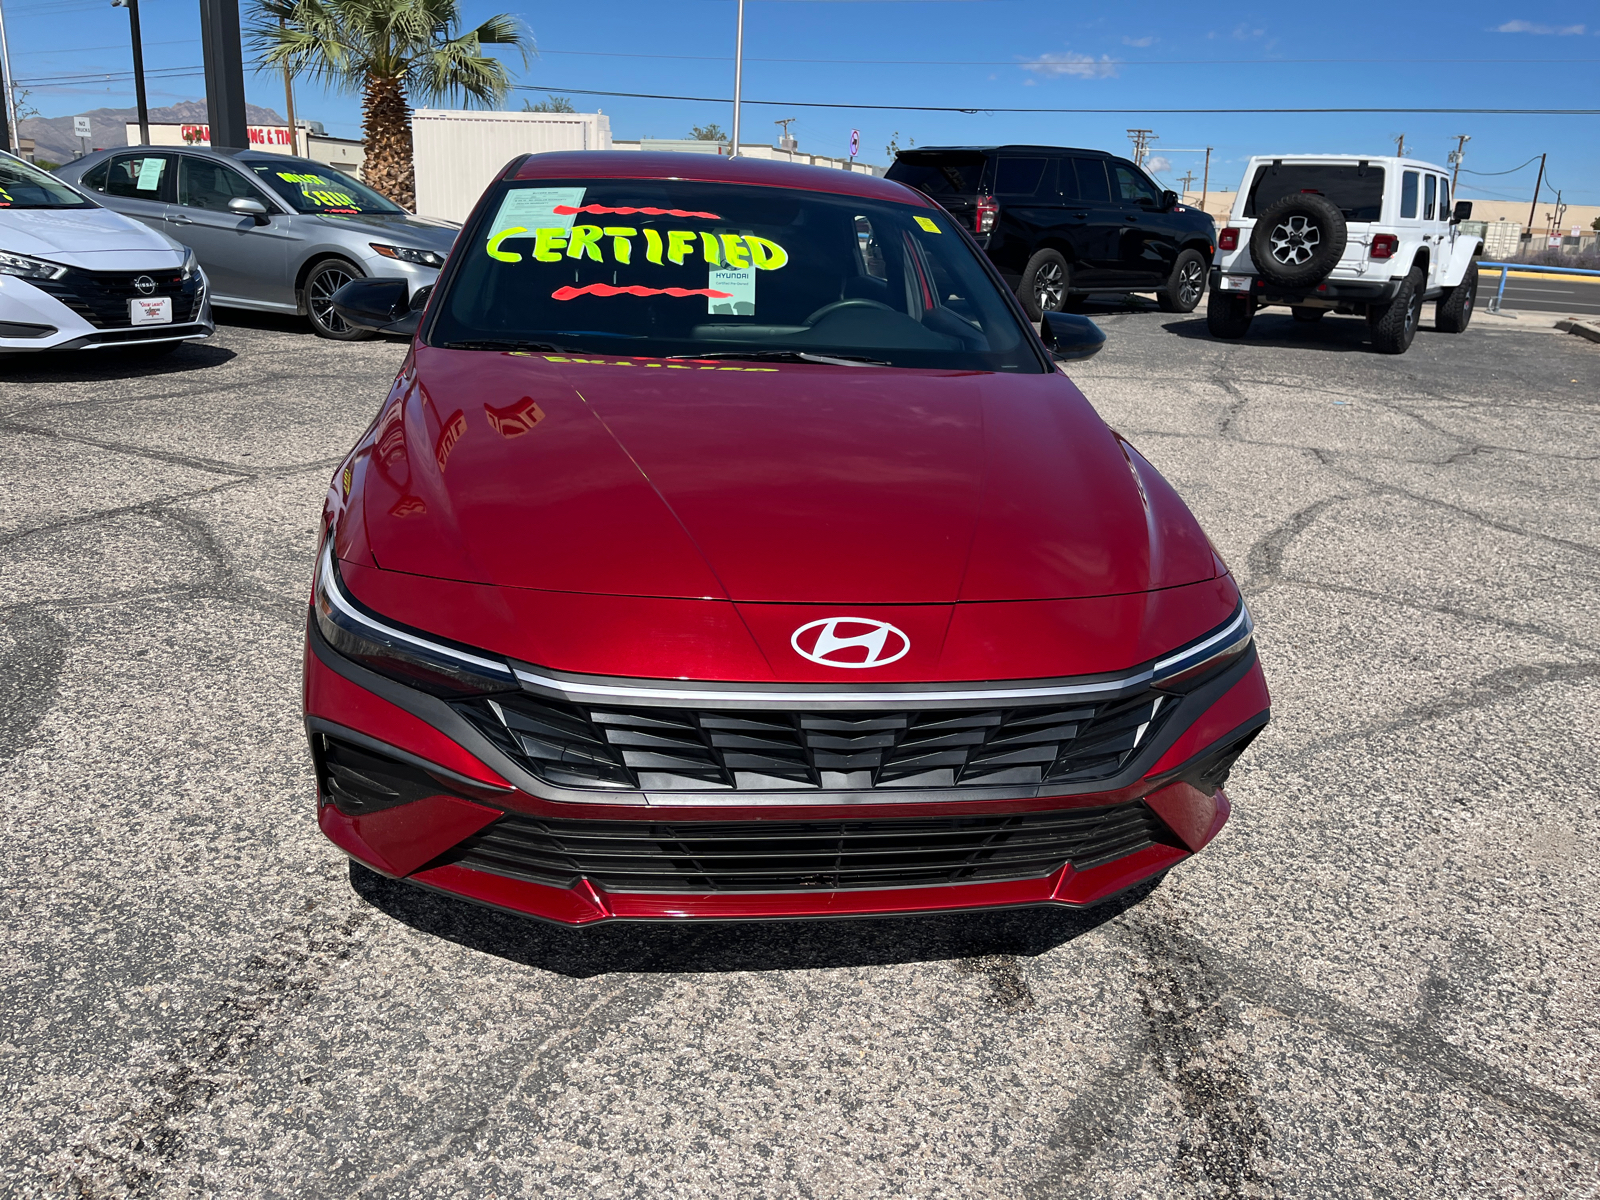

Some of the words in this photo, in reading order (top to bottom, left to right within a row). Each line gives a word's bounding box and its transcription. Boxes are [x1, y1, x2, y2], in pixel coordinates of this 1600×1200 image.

[267, 129, 274, 144] &
[276, 172, 326, 185] MUST
[487, 225, 788, 270] CERTIFIED
